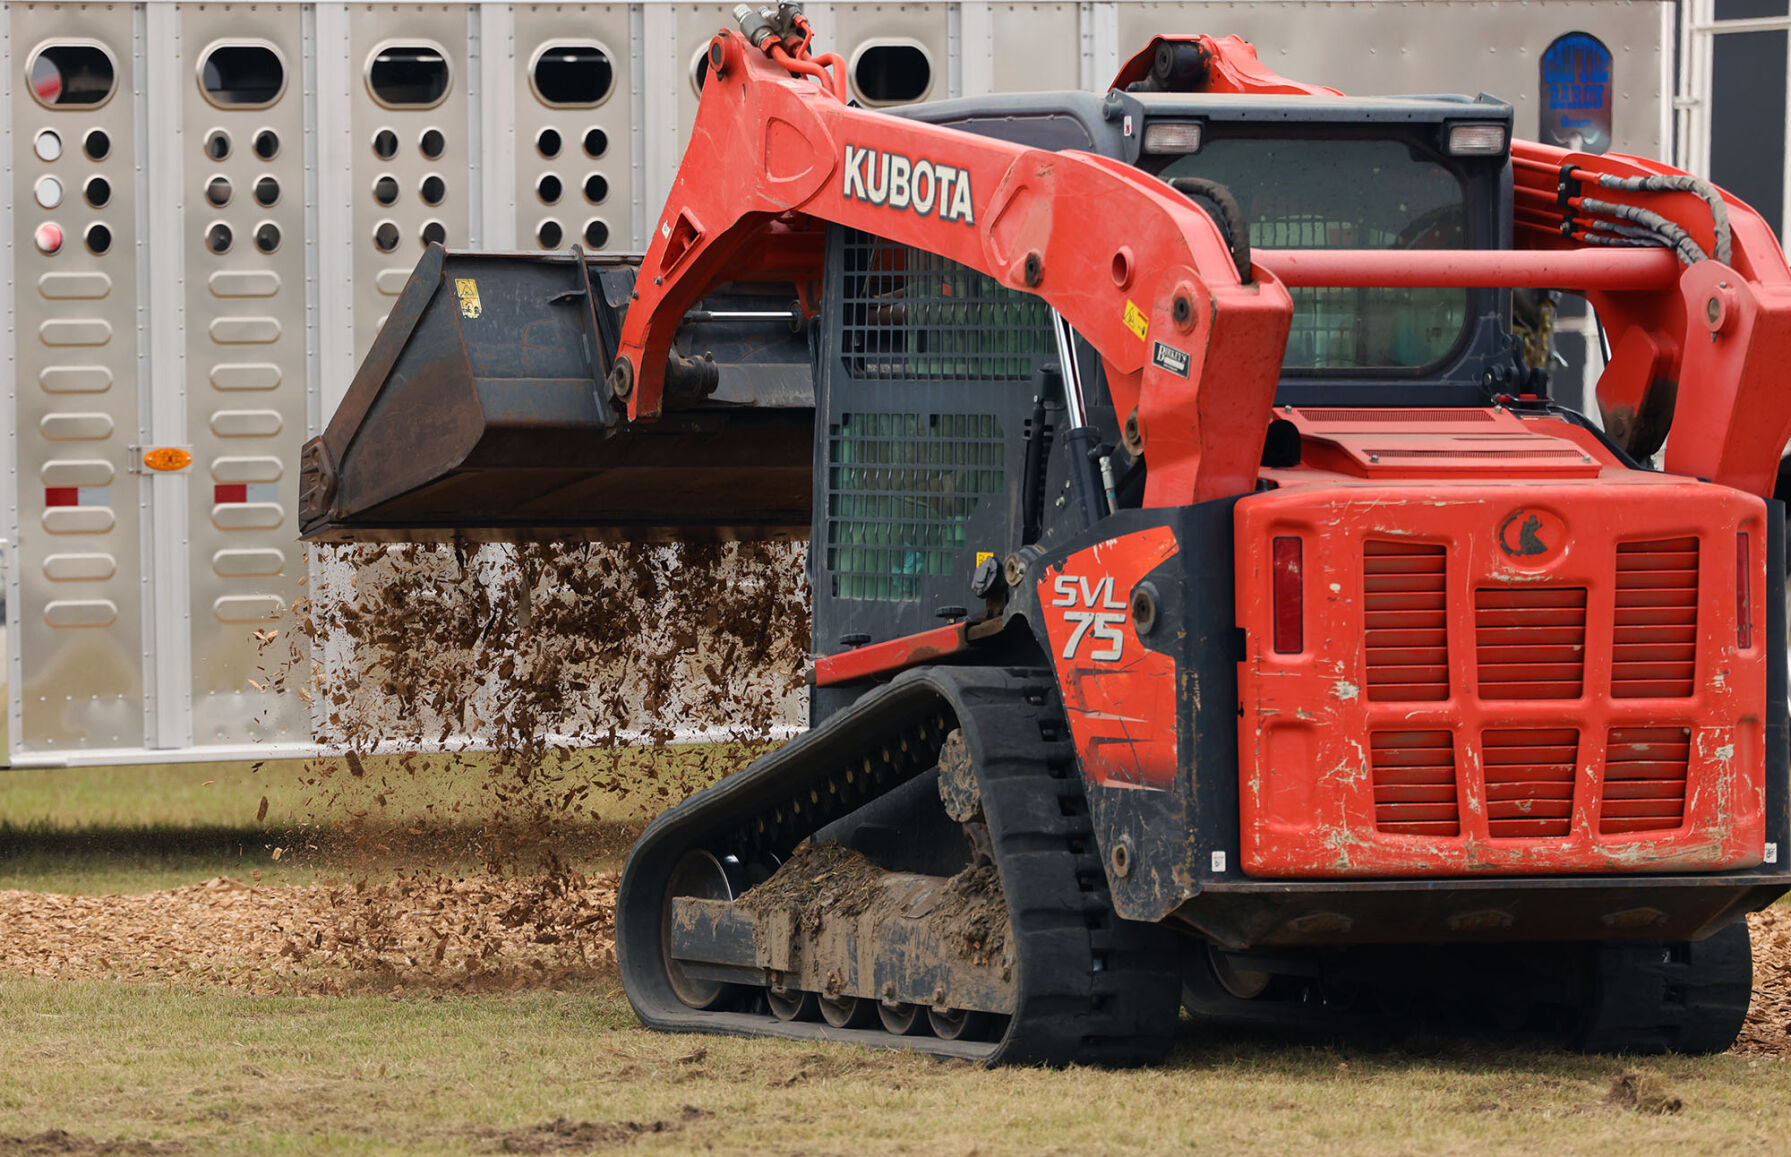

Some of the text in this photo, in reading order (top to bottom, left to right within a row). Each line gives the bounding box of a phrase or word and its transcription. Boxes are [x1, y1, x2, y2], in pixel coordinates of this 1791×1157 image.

[843, 144, 976, 226] KUBOTA
[1052, 575, 1127, 609] SVL
[1062, 611, 1126, 662] 75
